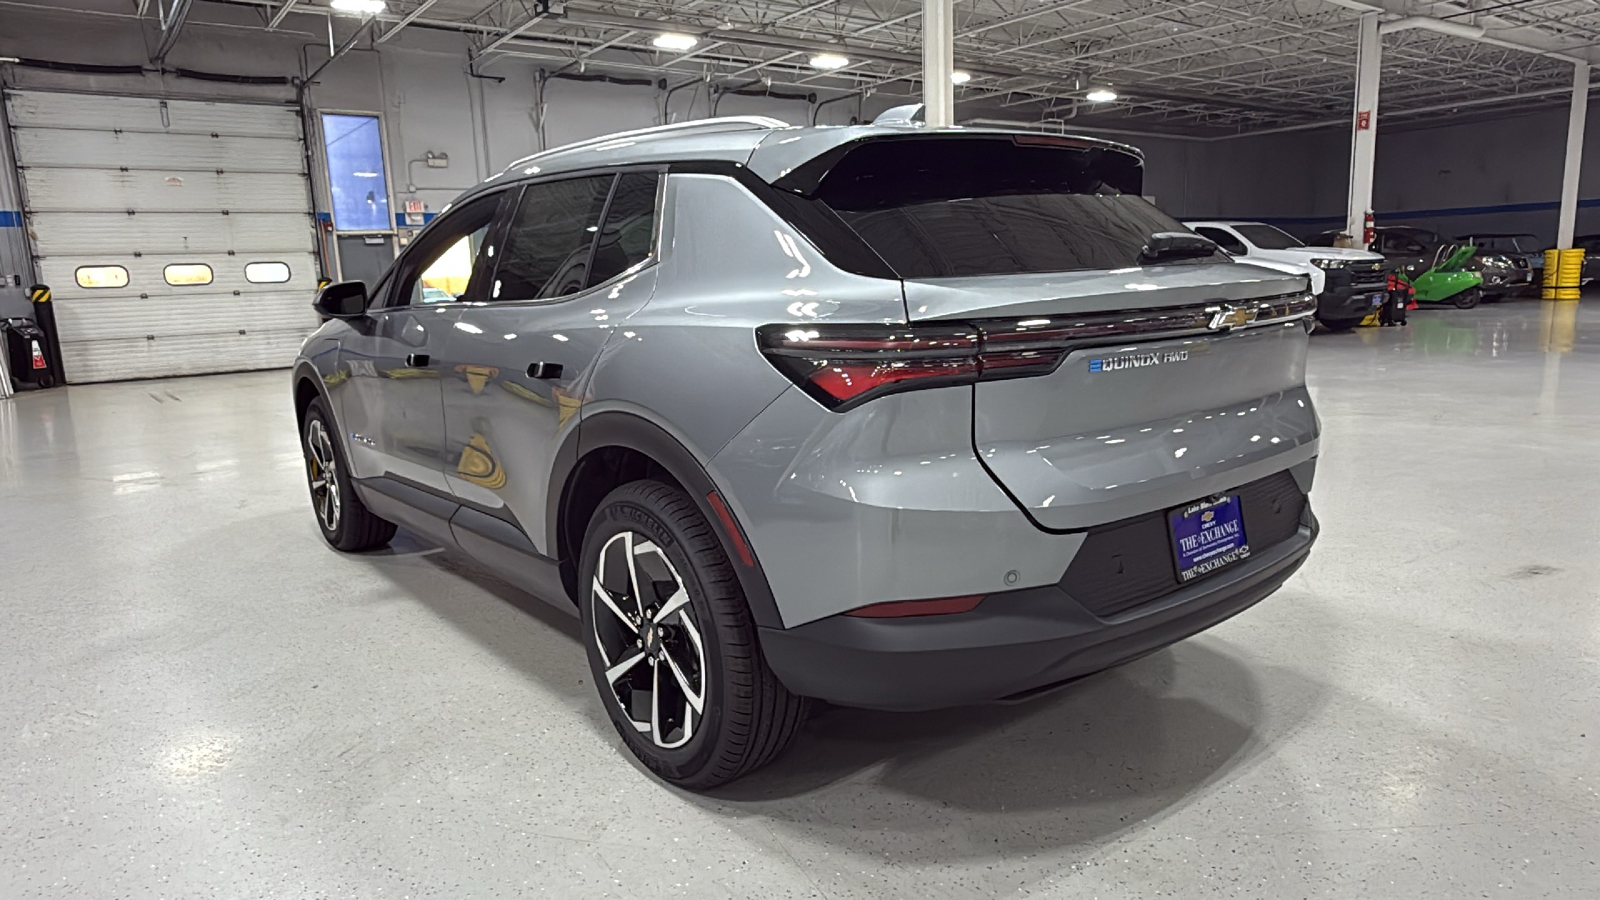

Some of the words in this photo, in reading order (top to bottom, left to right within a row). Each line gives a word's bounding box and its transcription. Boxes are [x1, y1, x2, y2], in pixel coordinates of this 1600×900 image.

[408, 200, 422, 211] EXIT
[1202, 521, 1216, 529] CHEVY
[1180, 534, 1199, 551] THE
[1200, 520, 1239, 544] EXCHANGE
[1181, 568, 1198, 581] THE
[1200, 552, 1240, 574] EXCHANGE
